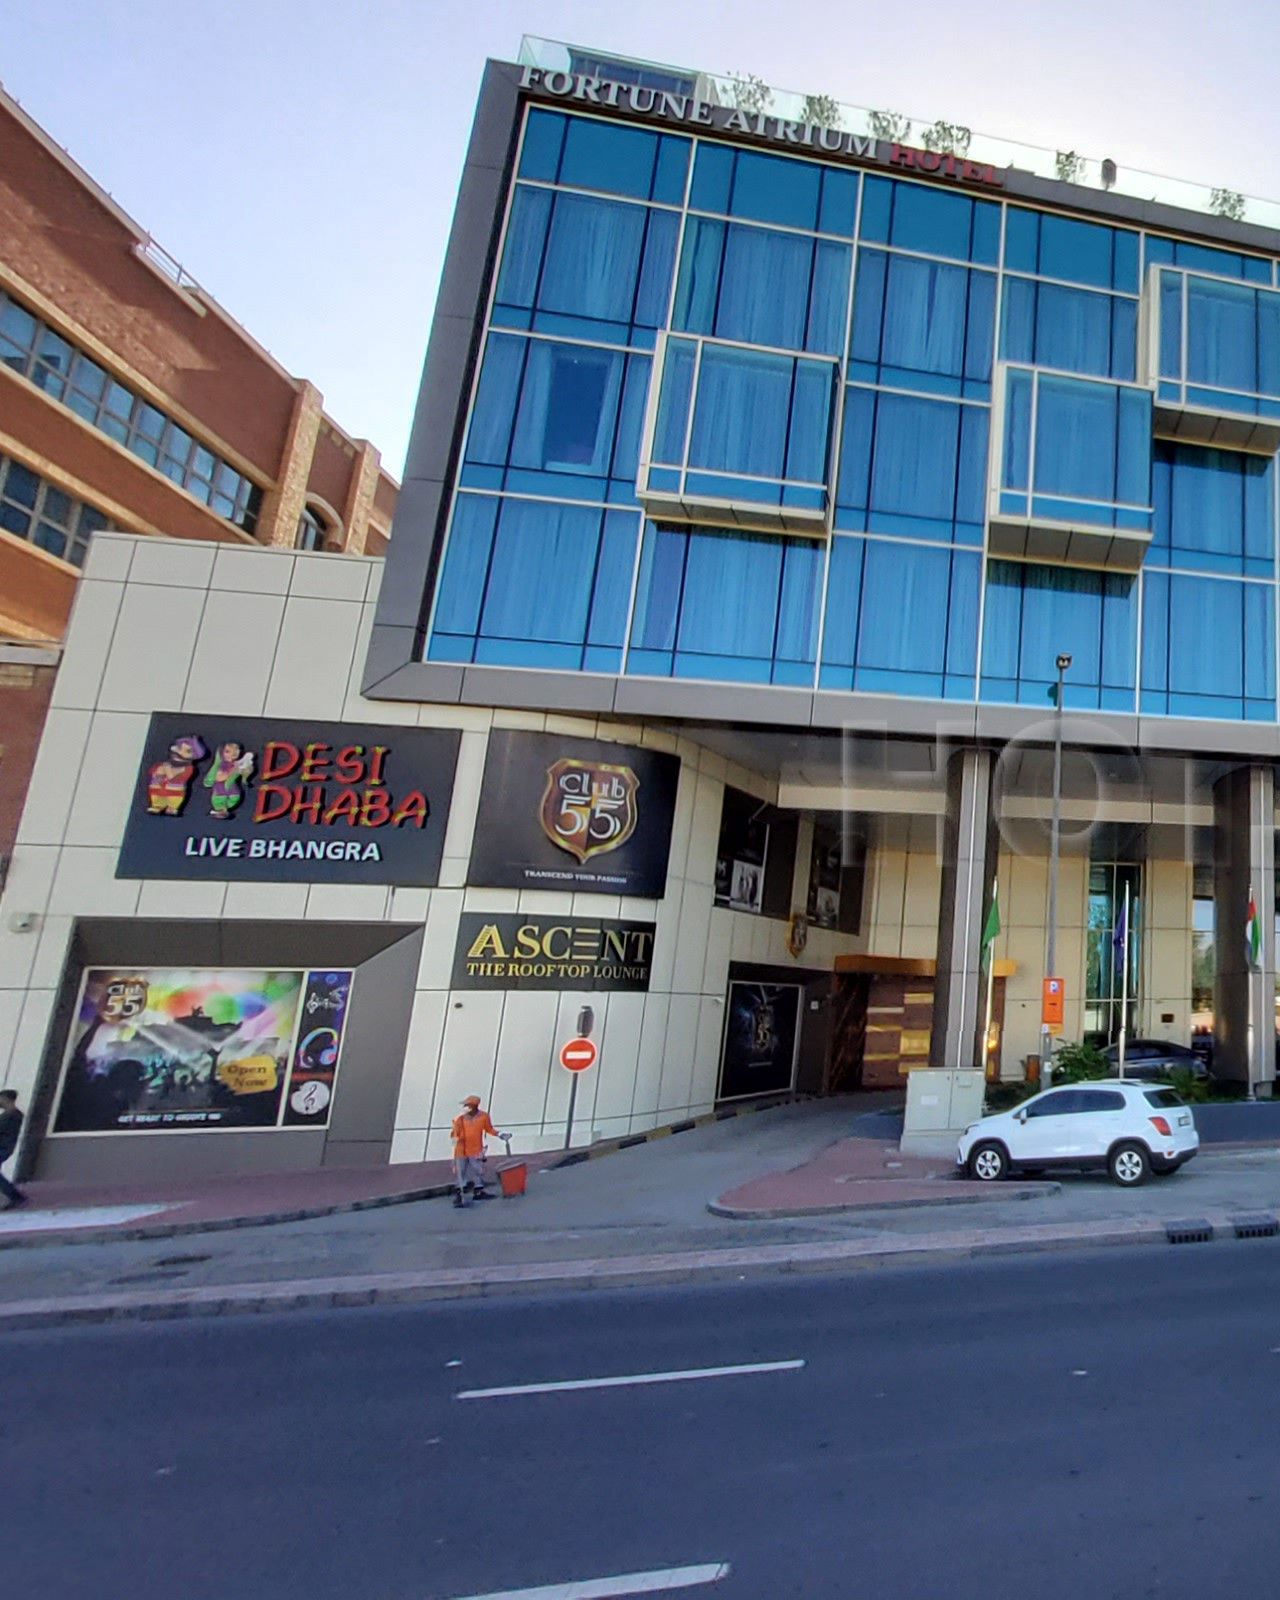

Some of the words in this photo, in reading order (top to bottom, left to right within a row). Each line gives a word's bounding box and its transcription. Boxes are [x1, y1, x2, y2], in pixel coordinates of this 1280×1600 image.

[518, 64, 714, 126] FORTUNE
[722, 109, 878, 161] ATRIUM
[888, 142, 1005, 186] HOTEL
[261, 741, 389, 785] DESI
[559, 772, 625, 799] Club
[253, 784, 428, 829] DHABA
[554, 794, 625, 839] 55
[185, 837, 244, 858] LIVE
[249, 838, 381, 862] BHANGRA
[467, 923, 654, 963] ASCENT
[467, 962, 505, 977] THE
[593, 966, 648, 980] LOUNGE
[104, 995, 140, 1016] 55
[227, 1064, 267, 1076] Open
